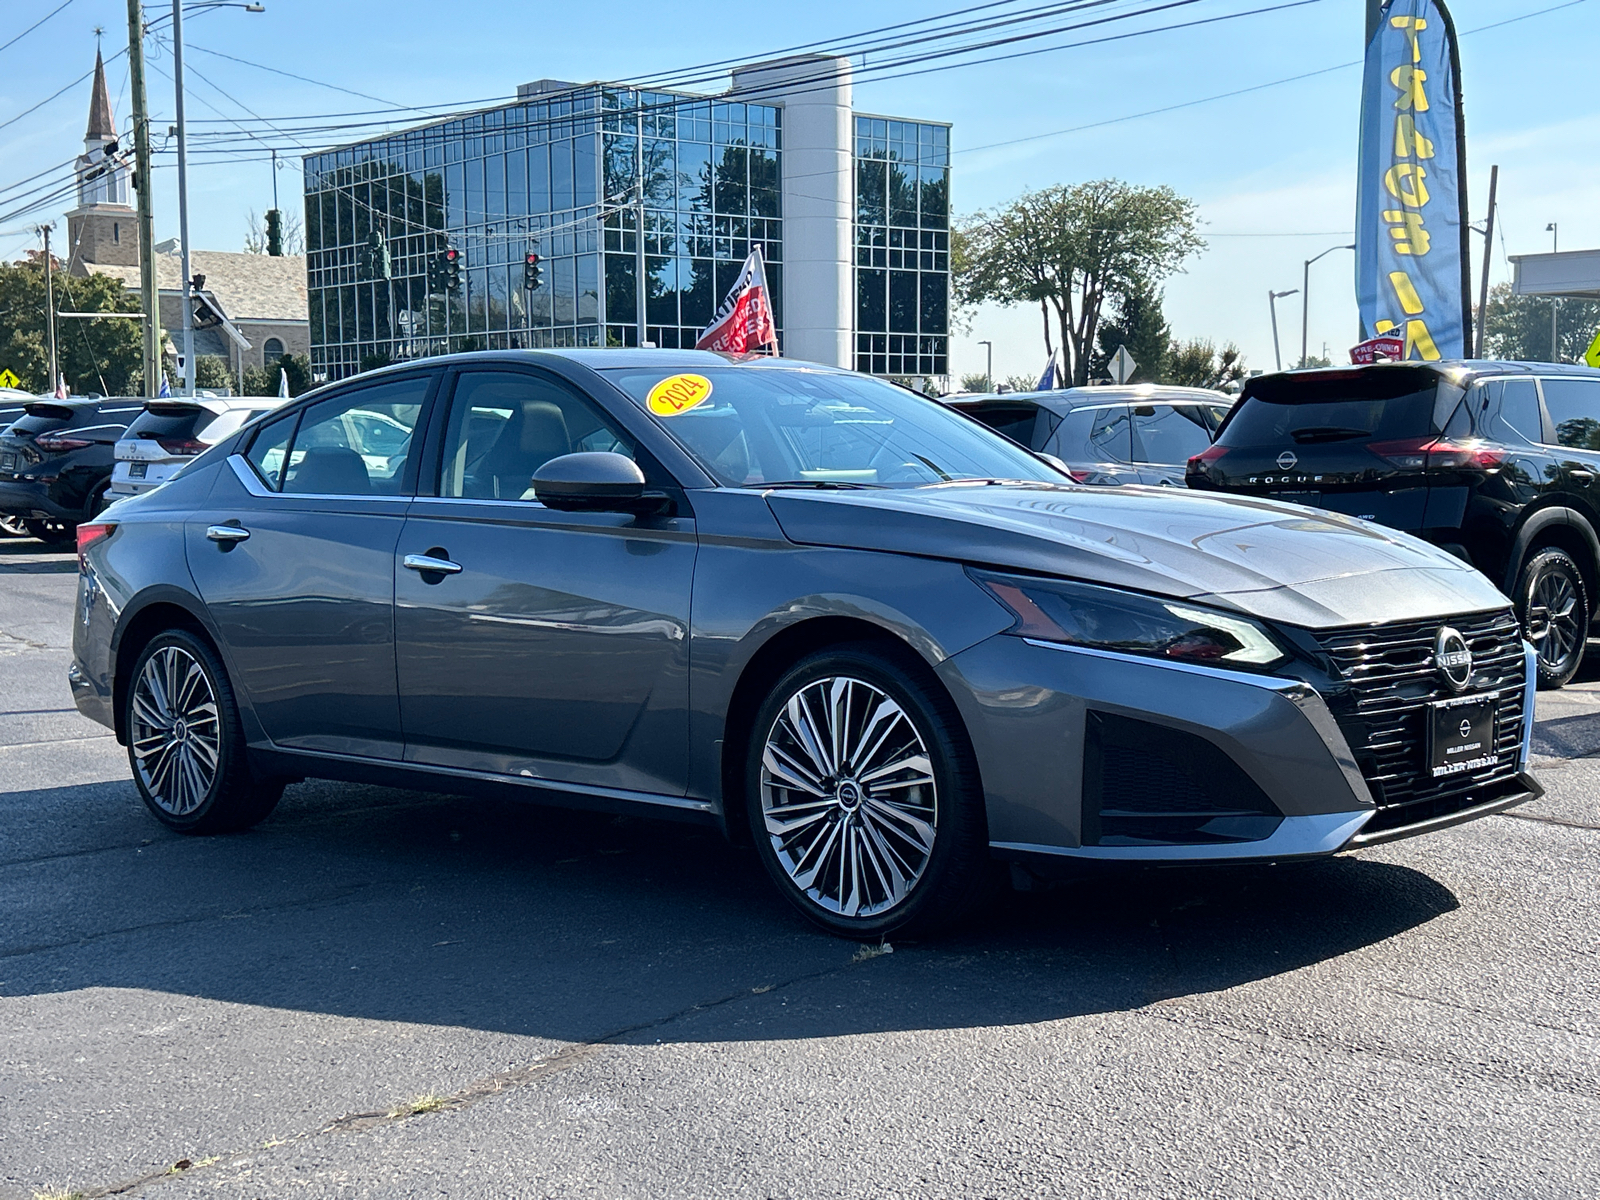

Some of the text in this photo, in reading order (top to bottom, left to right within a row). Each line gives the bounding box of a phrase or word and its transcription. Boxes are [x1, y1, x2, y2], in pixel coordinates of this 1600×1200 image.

[1354, 343, 1400, 354] PRE-OWNED
[658, 377, 704, 410] 2024
[1249, 475, 1323, 484] ROGUE
[1437, 652, 1472, 666] NISSAN
[1446, 742, 1481, 754] MILLER NISSAN
[1432, 755, 1498, 777] MILLER NISSAN
